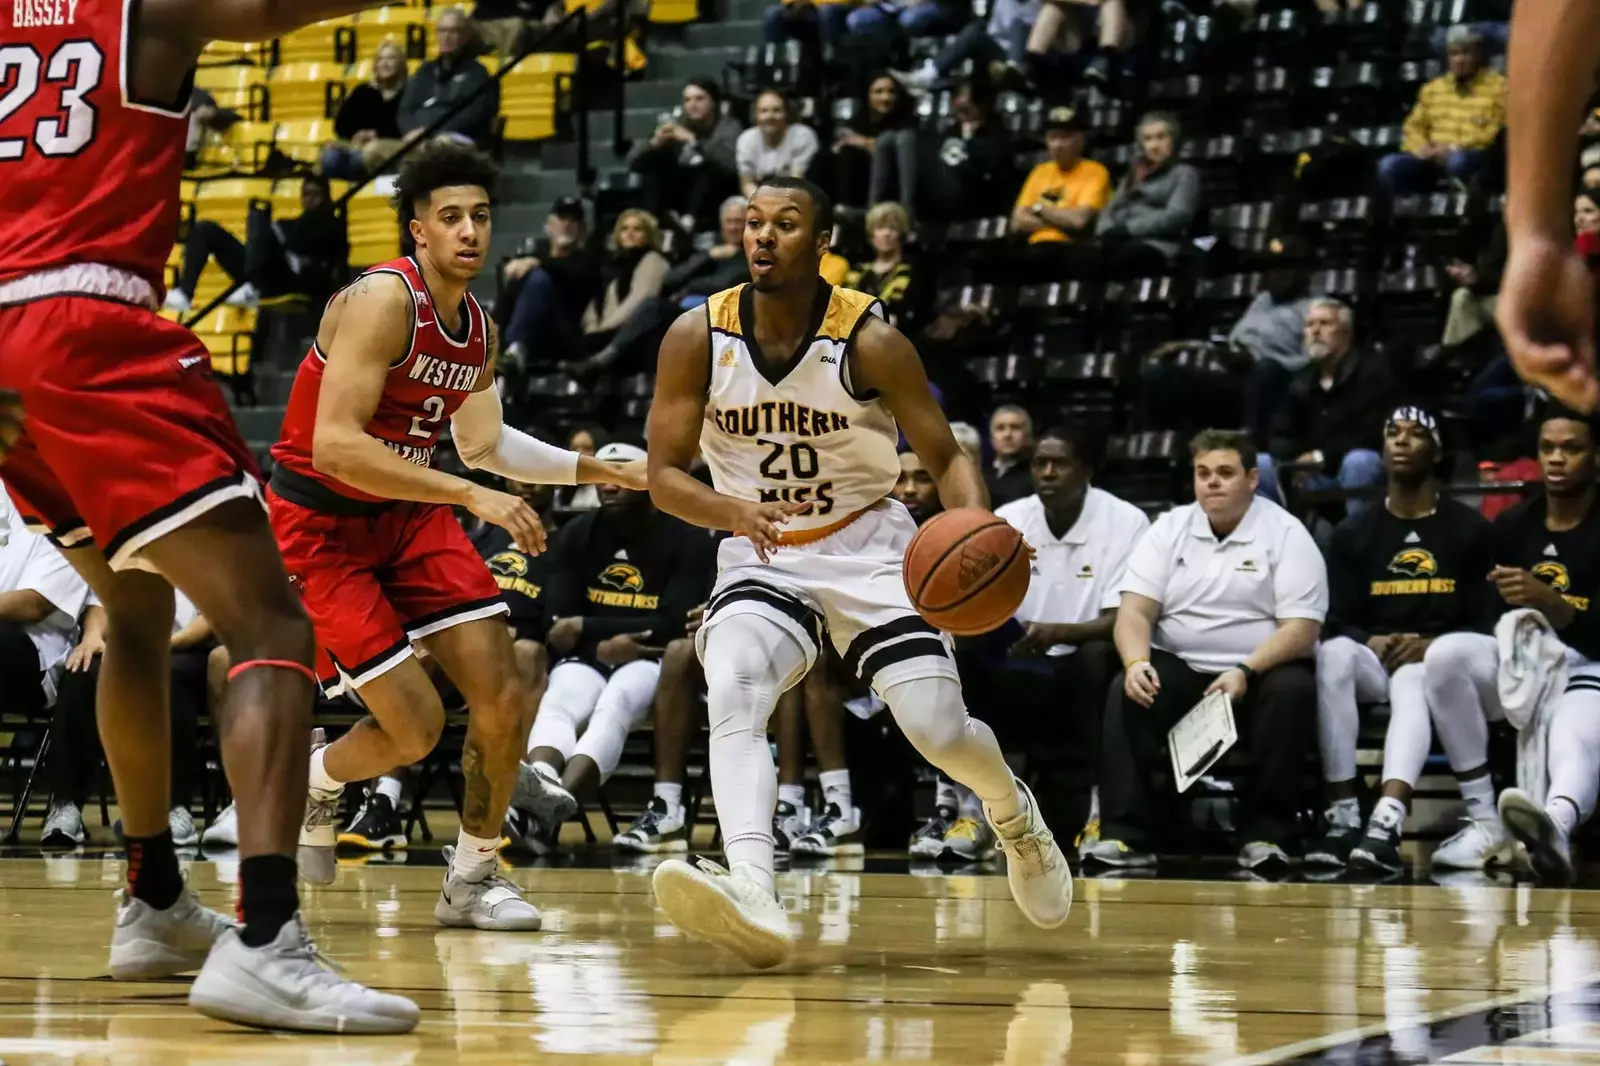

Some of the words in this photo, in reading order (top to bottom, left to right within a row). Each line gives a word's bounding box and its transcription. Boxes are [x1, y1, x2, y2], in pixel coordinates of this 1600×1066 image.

[12, 0, 79, 28] BASSEY
[0, 37, 105, 161] 23
[408, 352, 481, 392] WESTERN
[407, 395, 445, 439] 2
[715, 402, 850, 437] SOUTHERN
[757, 438, 819, 481] 20
